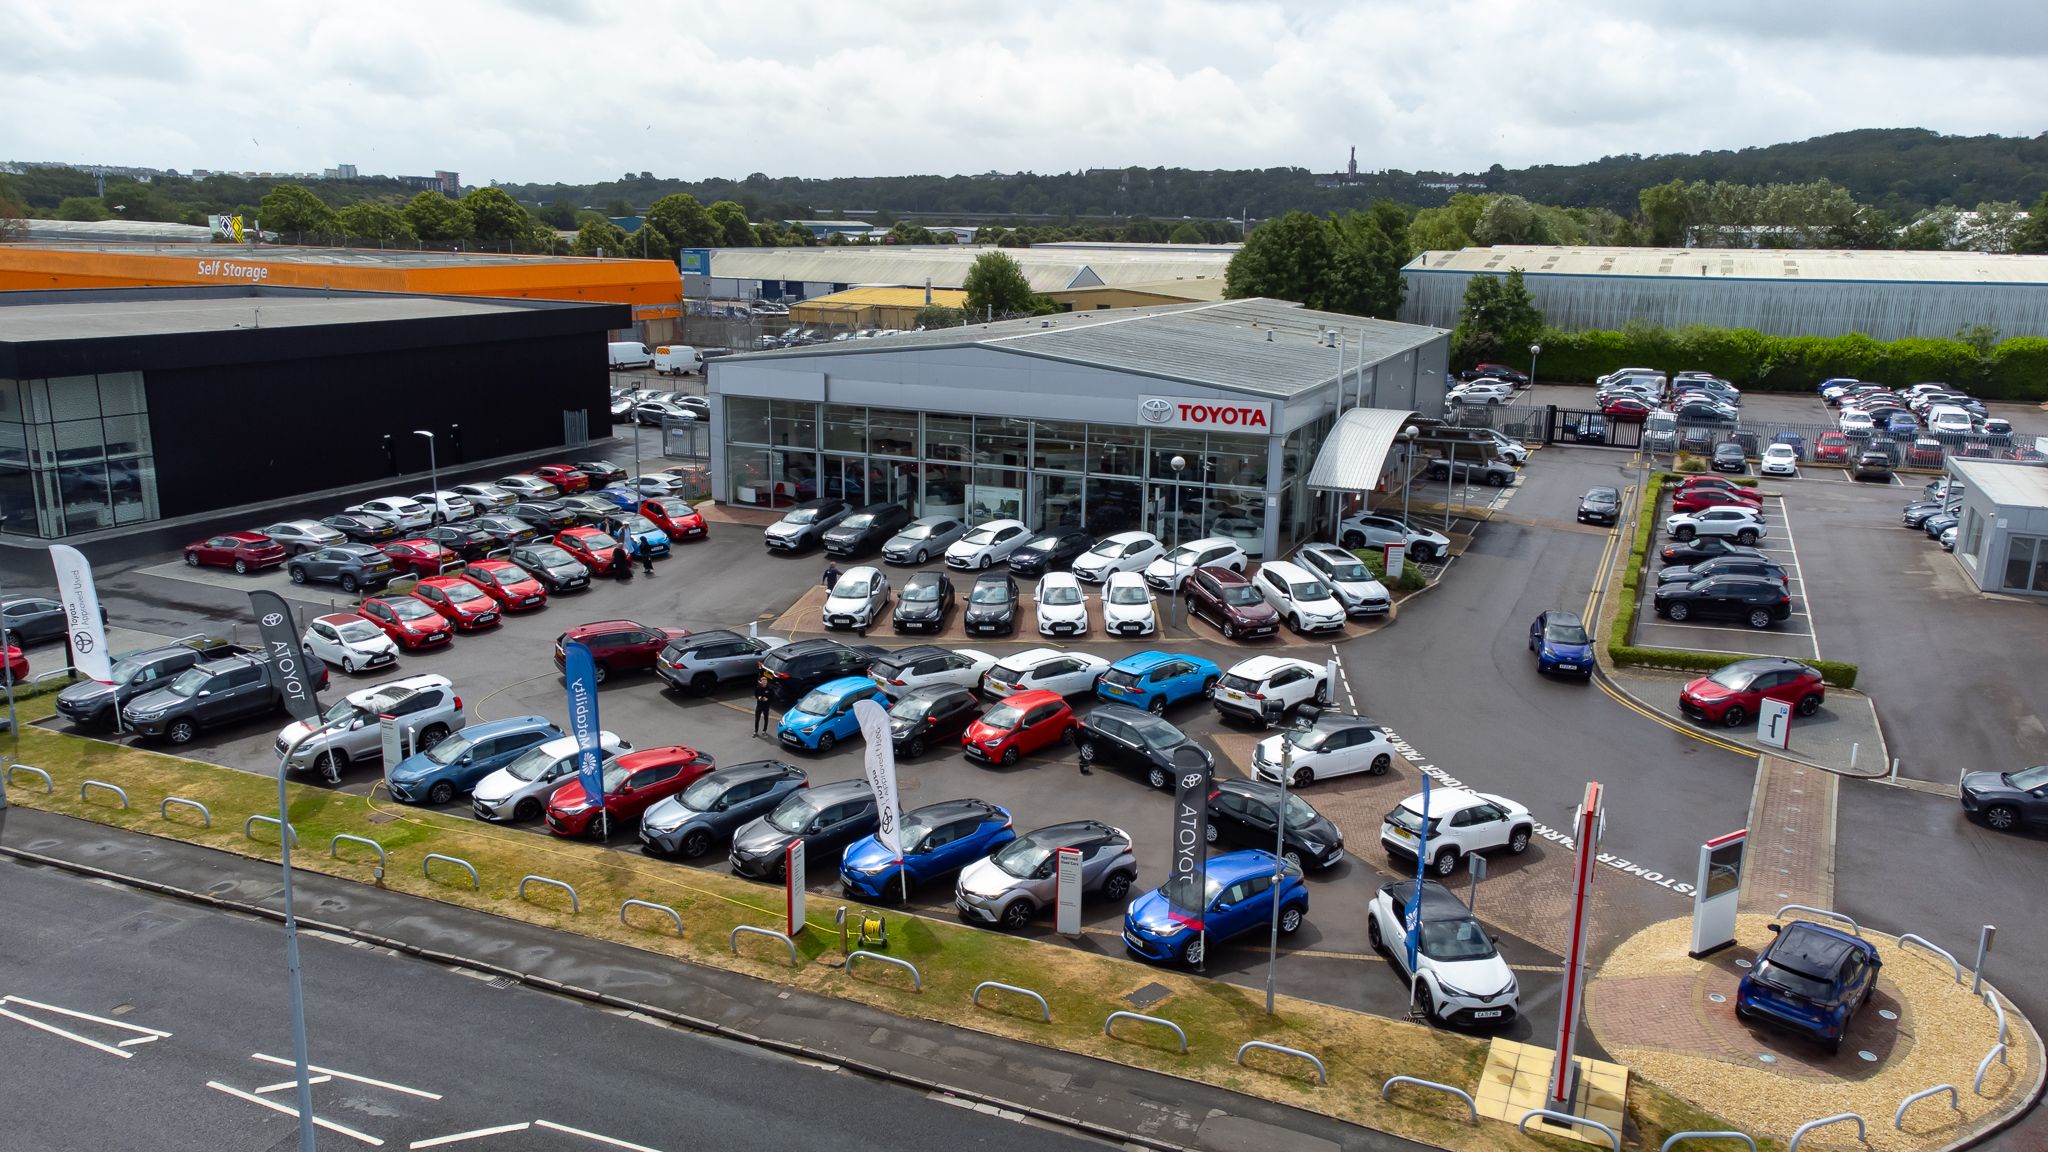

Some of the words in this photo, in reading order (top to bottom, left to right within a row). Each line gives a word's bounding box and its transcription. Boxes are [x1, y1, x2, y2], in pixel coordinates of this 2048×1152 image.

[198, 261, 221, 276] Self
[223, 262, 268, 281] Storage
[1178, 404, 1267, 427] TOYOTA
[71, 570, 82, 590] Used
[69, 603, 80, 627] Toyota
[75, 591, 89, 626] Approved
[1418, 764, 1478, 796] STOMER
[1595, 852, 1698, 897] STOMER
